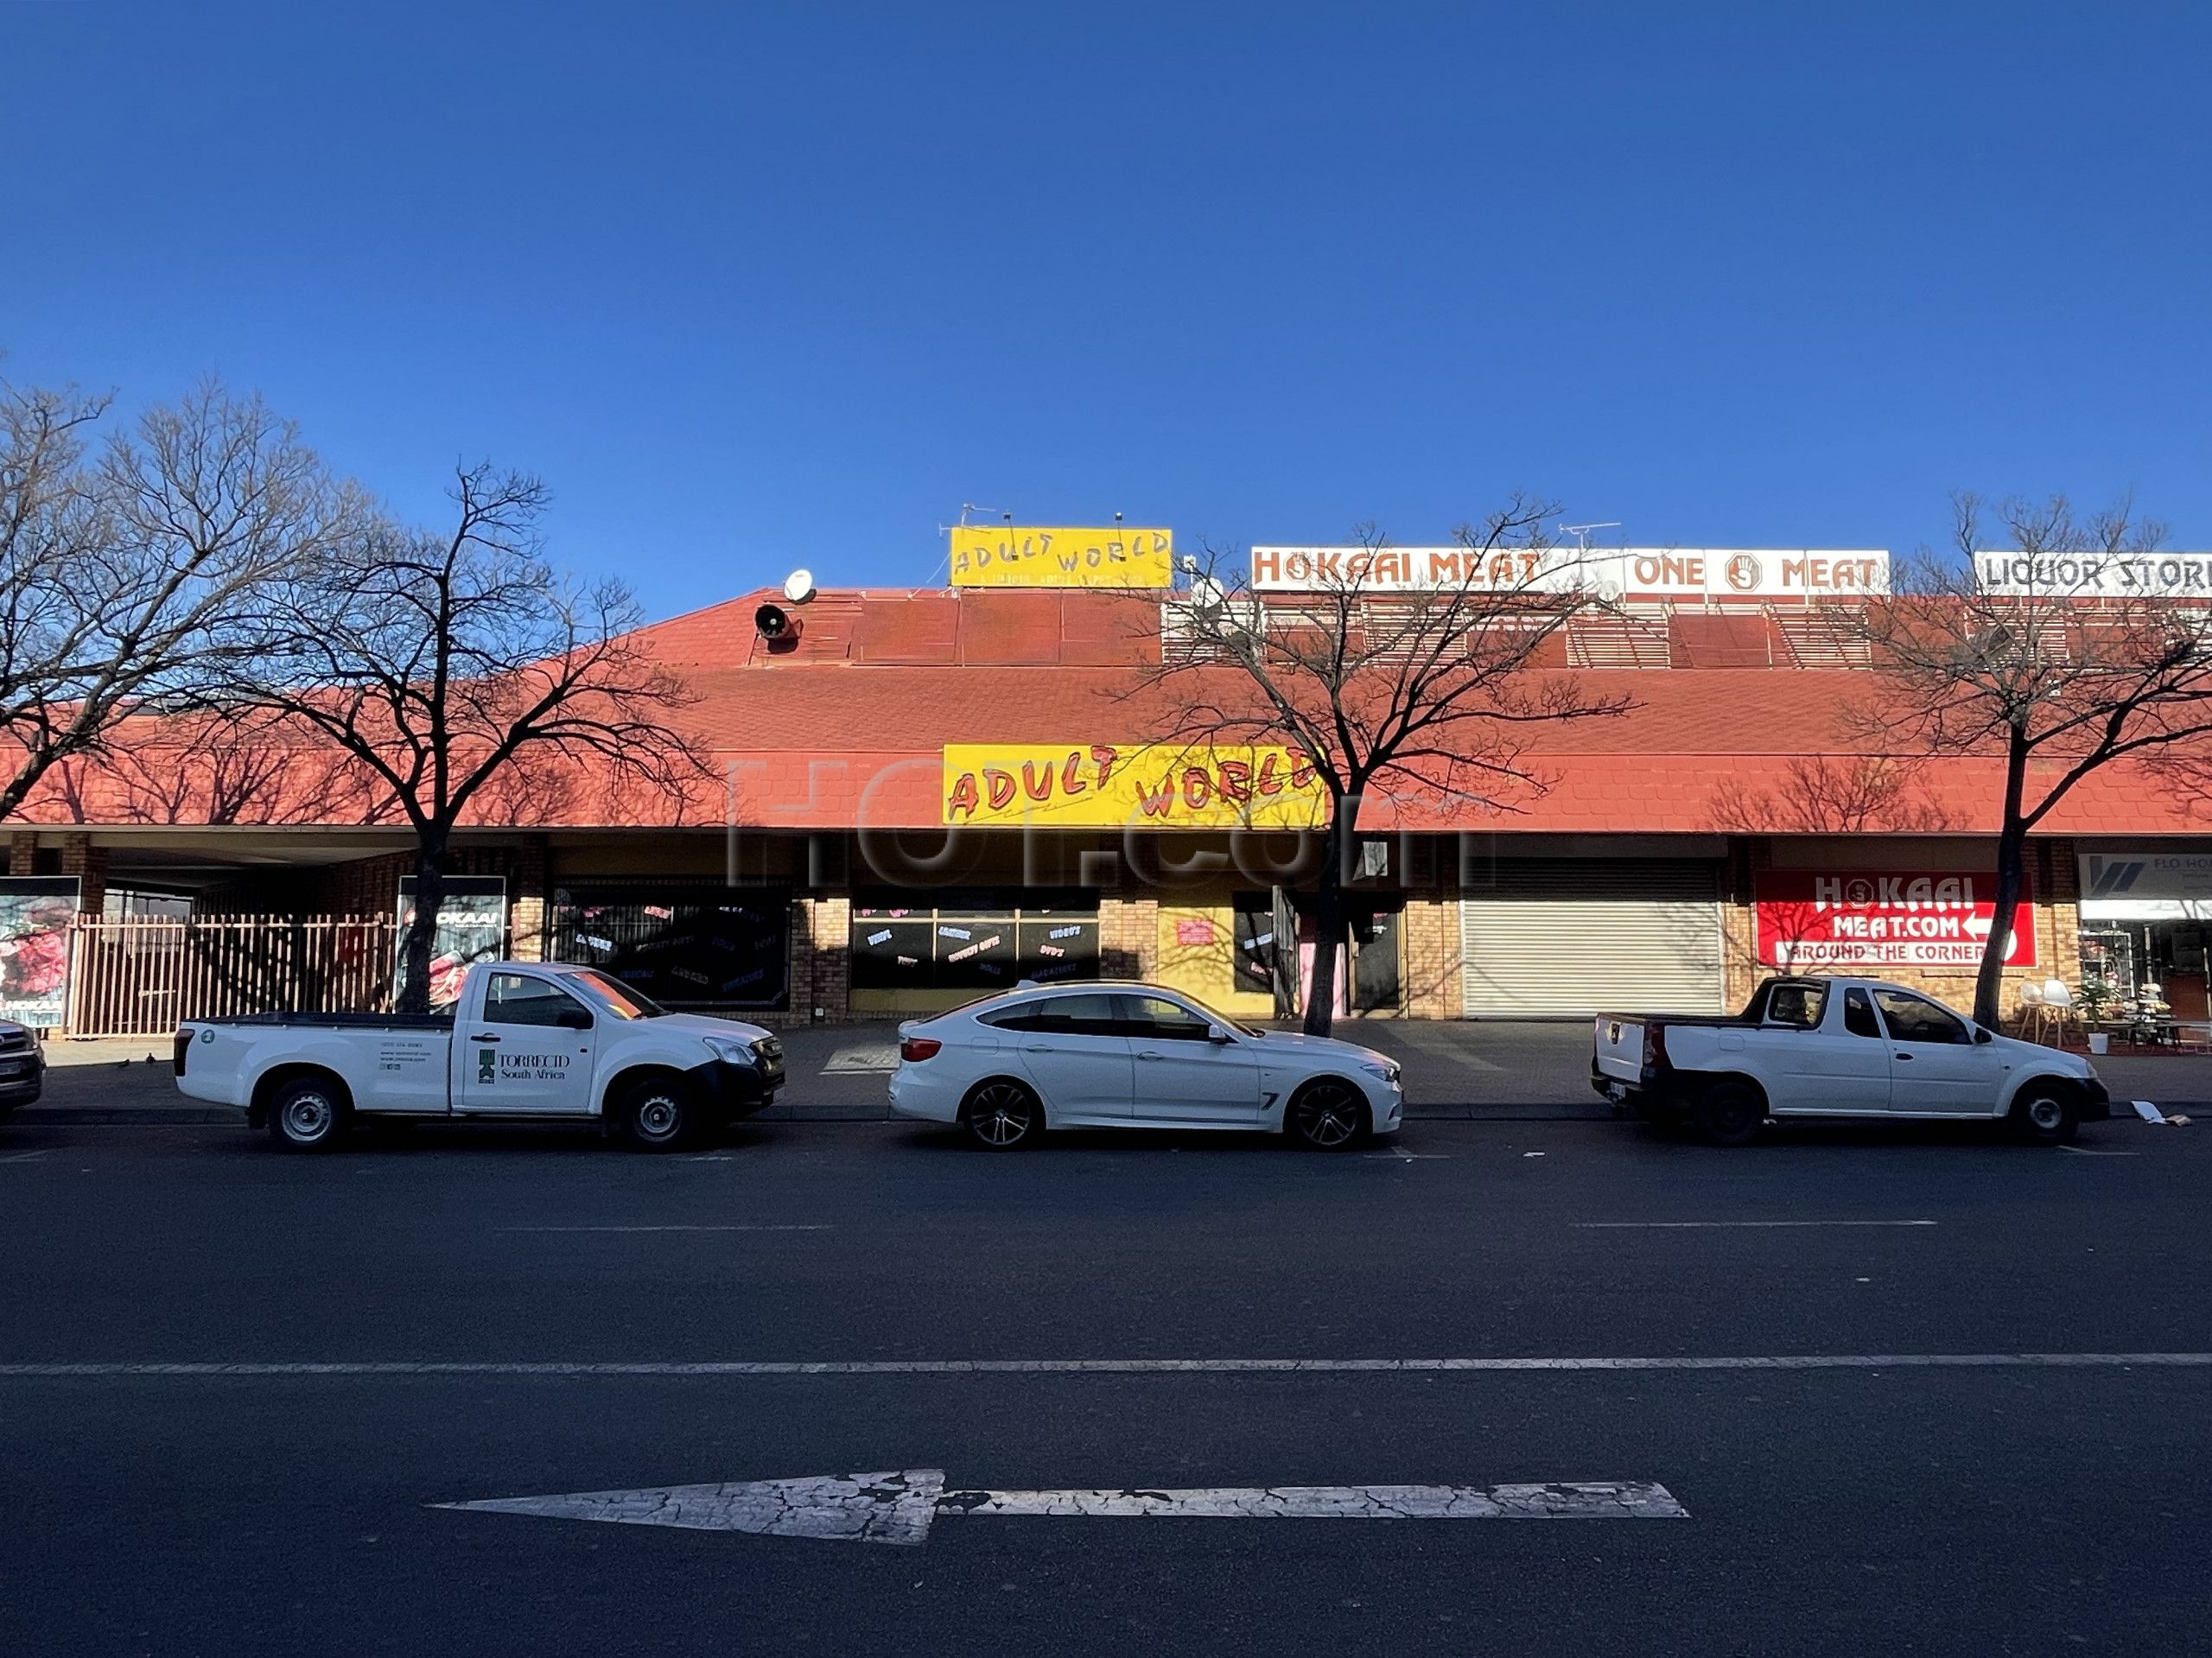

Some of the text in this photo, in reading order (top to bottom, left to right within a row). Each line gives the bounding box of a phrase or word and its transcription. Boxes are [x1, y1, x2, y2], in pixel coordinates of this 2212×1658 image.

[955, 531, 1168, 575] ADULT WORLD
[1254, 551, 1541, 585] HOKAAI MEAT
[1635, 558, 1877, 588] ONE MEAT
[1987, 558, 2212, 589] LIQUOR STOR
[949, 746, 1318, 820] ADULT WORLD
[2154, 858, 2212, 868] FLO HO
[435, 912, 498, 924] OKAAI
[1833, 916, 1960, 939] MEAT.COM
[1790, 944, 1866, 960] AROUND
[1874, 944, 1907, 961] THE
[5, 1000, 64, 1011] HOKAA
[499, 1054, 570, 1068] TORRECID
[501, 1070, 565, 1079] South Africa
